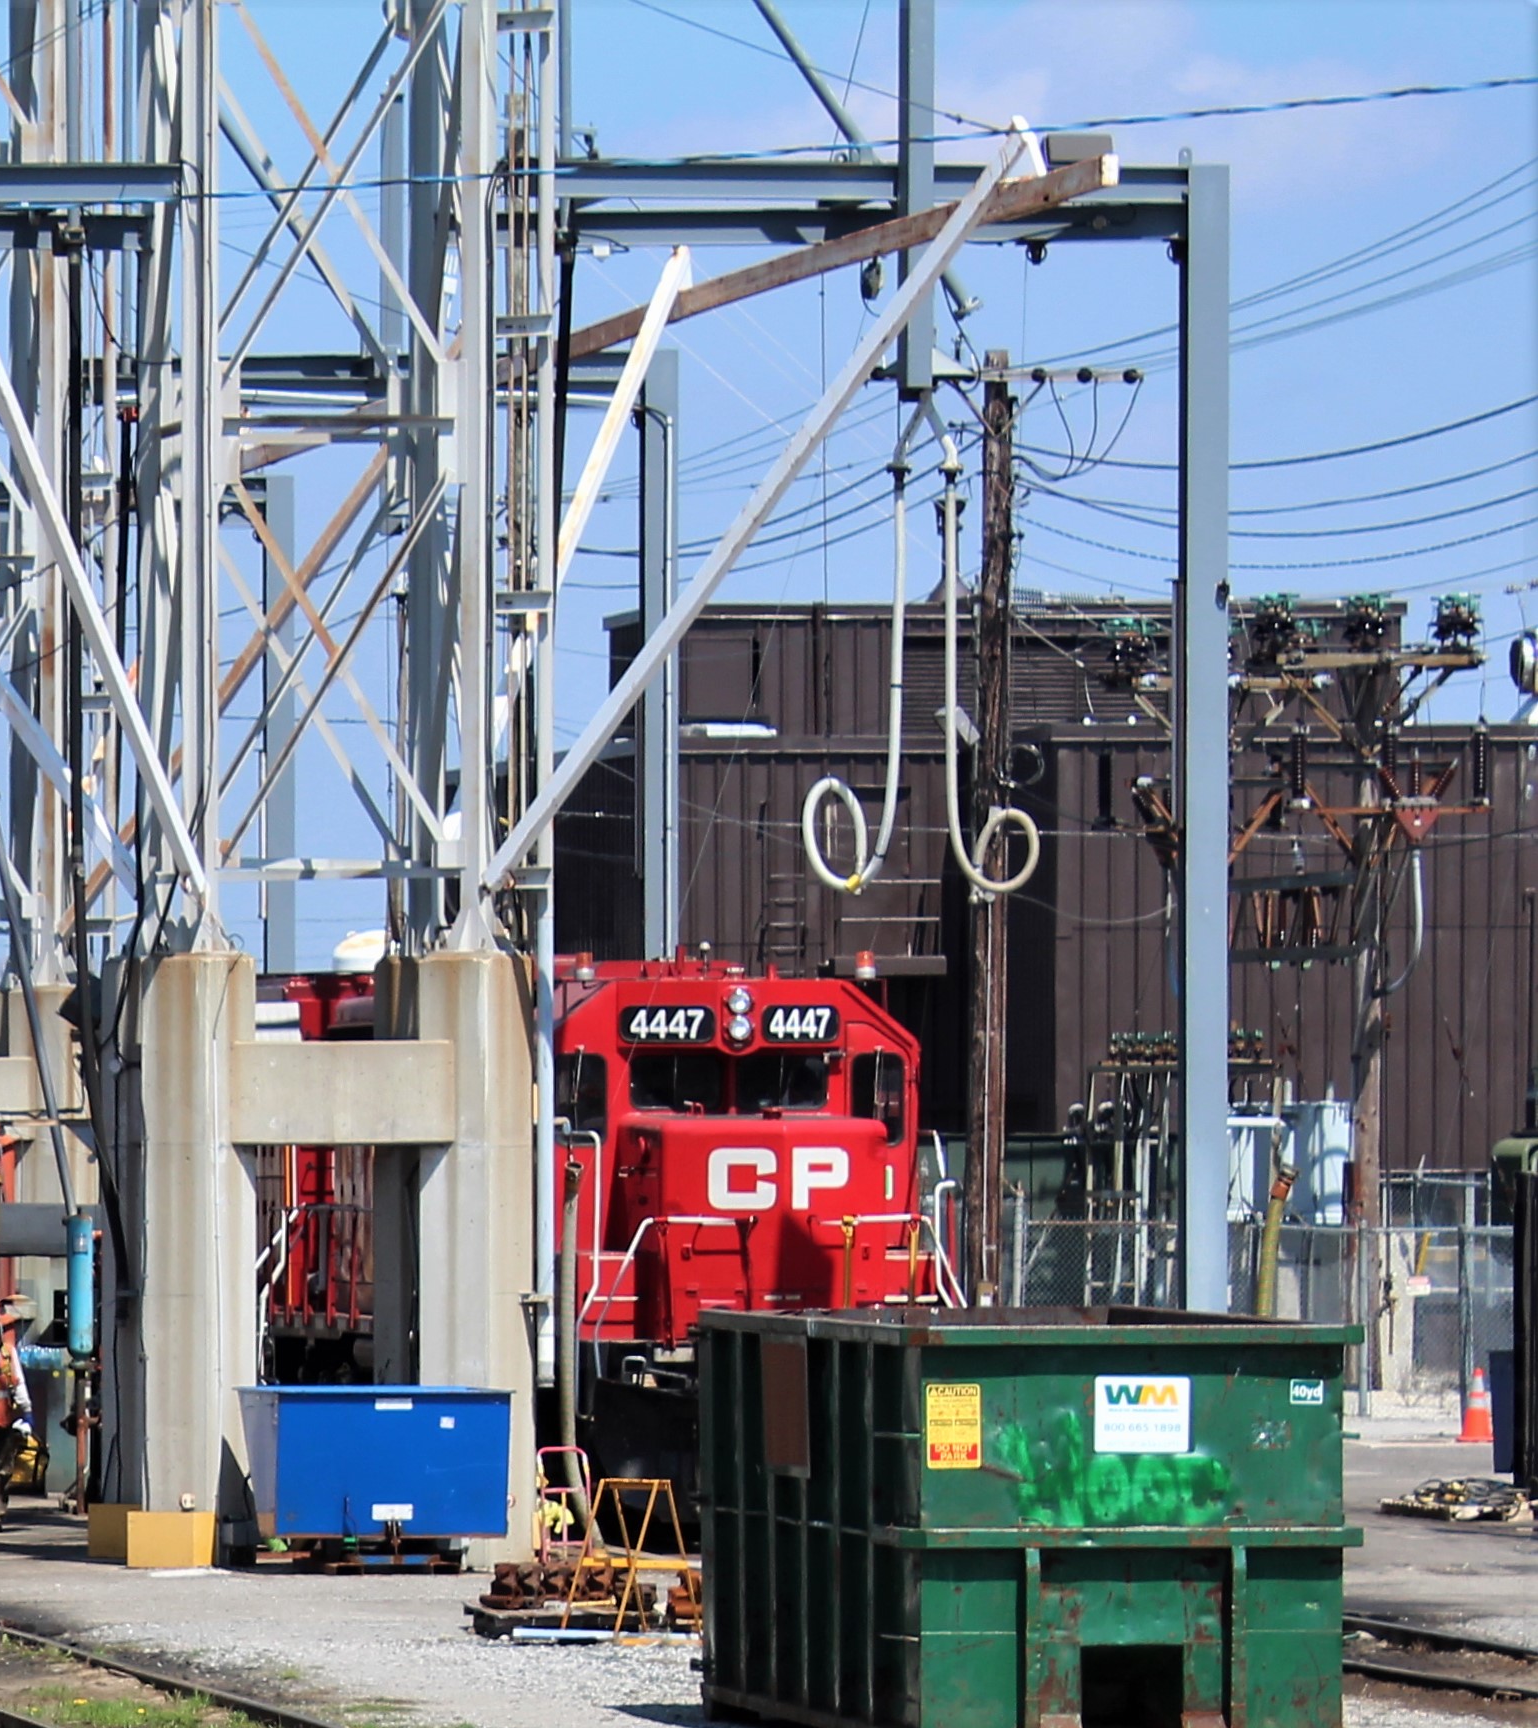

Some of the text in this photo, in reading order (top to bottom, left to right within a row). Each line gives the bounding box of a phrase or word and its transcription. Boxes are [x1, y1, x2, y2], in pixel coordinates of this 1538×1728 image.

[629, 1009, 705, 1039] 4447
[769, 1008, 831, 1039] 4447
[707, 1147, 850, 1210] CP
[937, 1386, 977, 1397] CAUTION
[1104, 1384, 1178, 1406] WM
[1293, 1384, 1321, 1400] 40yd
[935, 1443, 972, 1453] DO NOT
[940, 1453, 967, 1462] PARK
